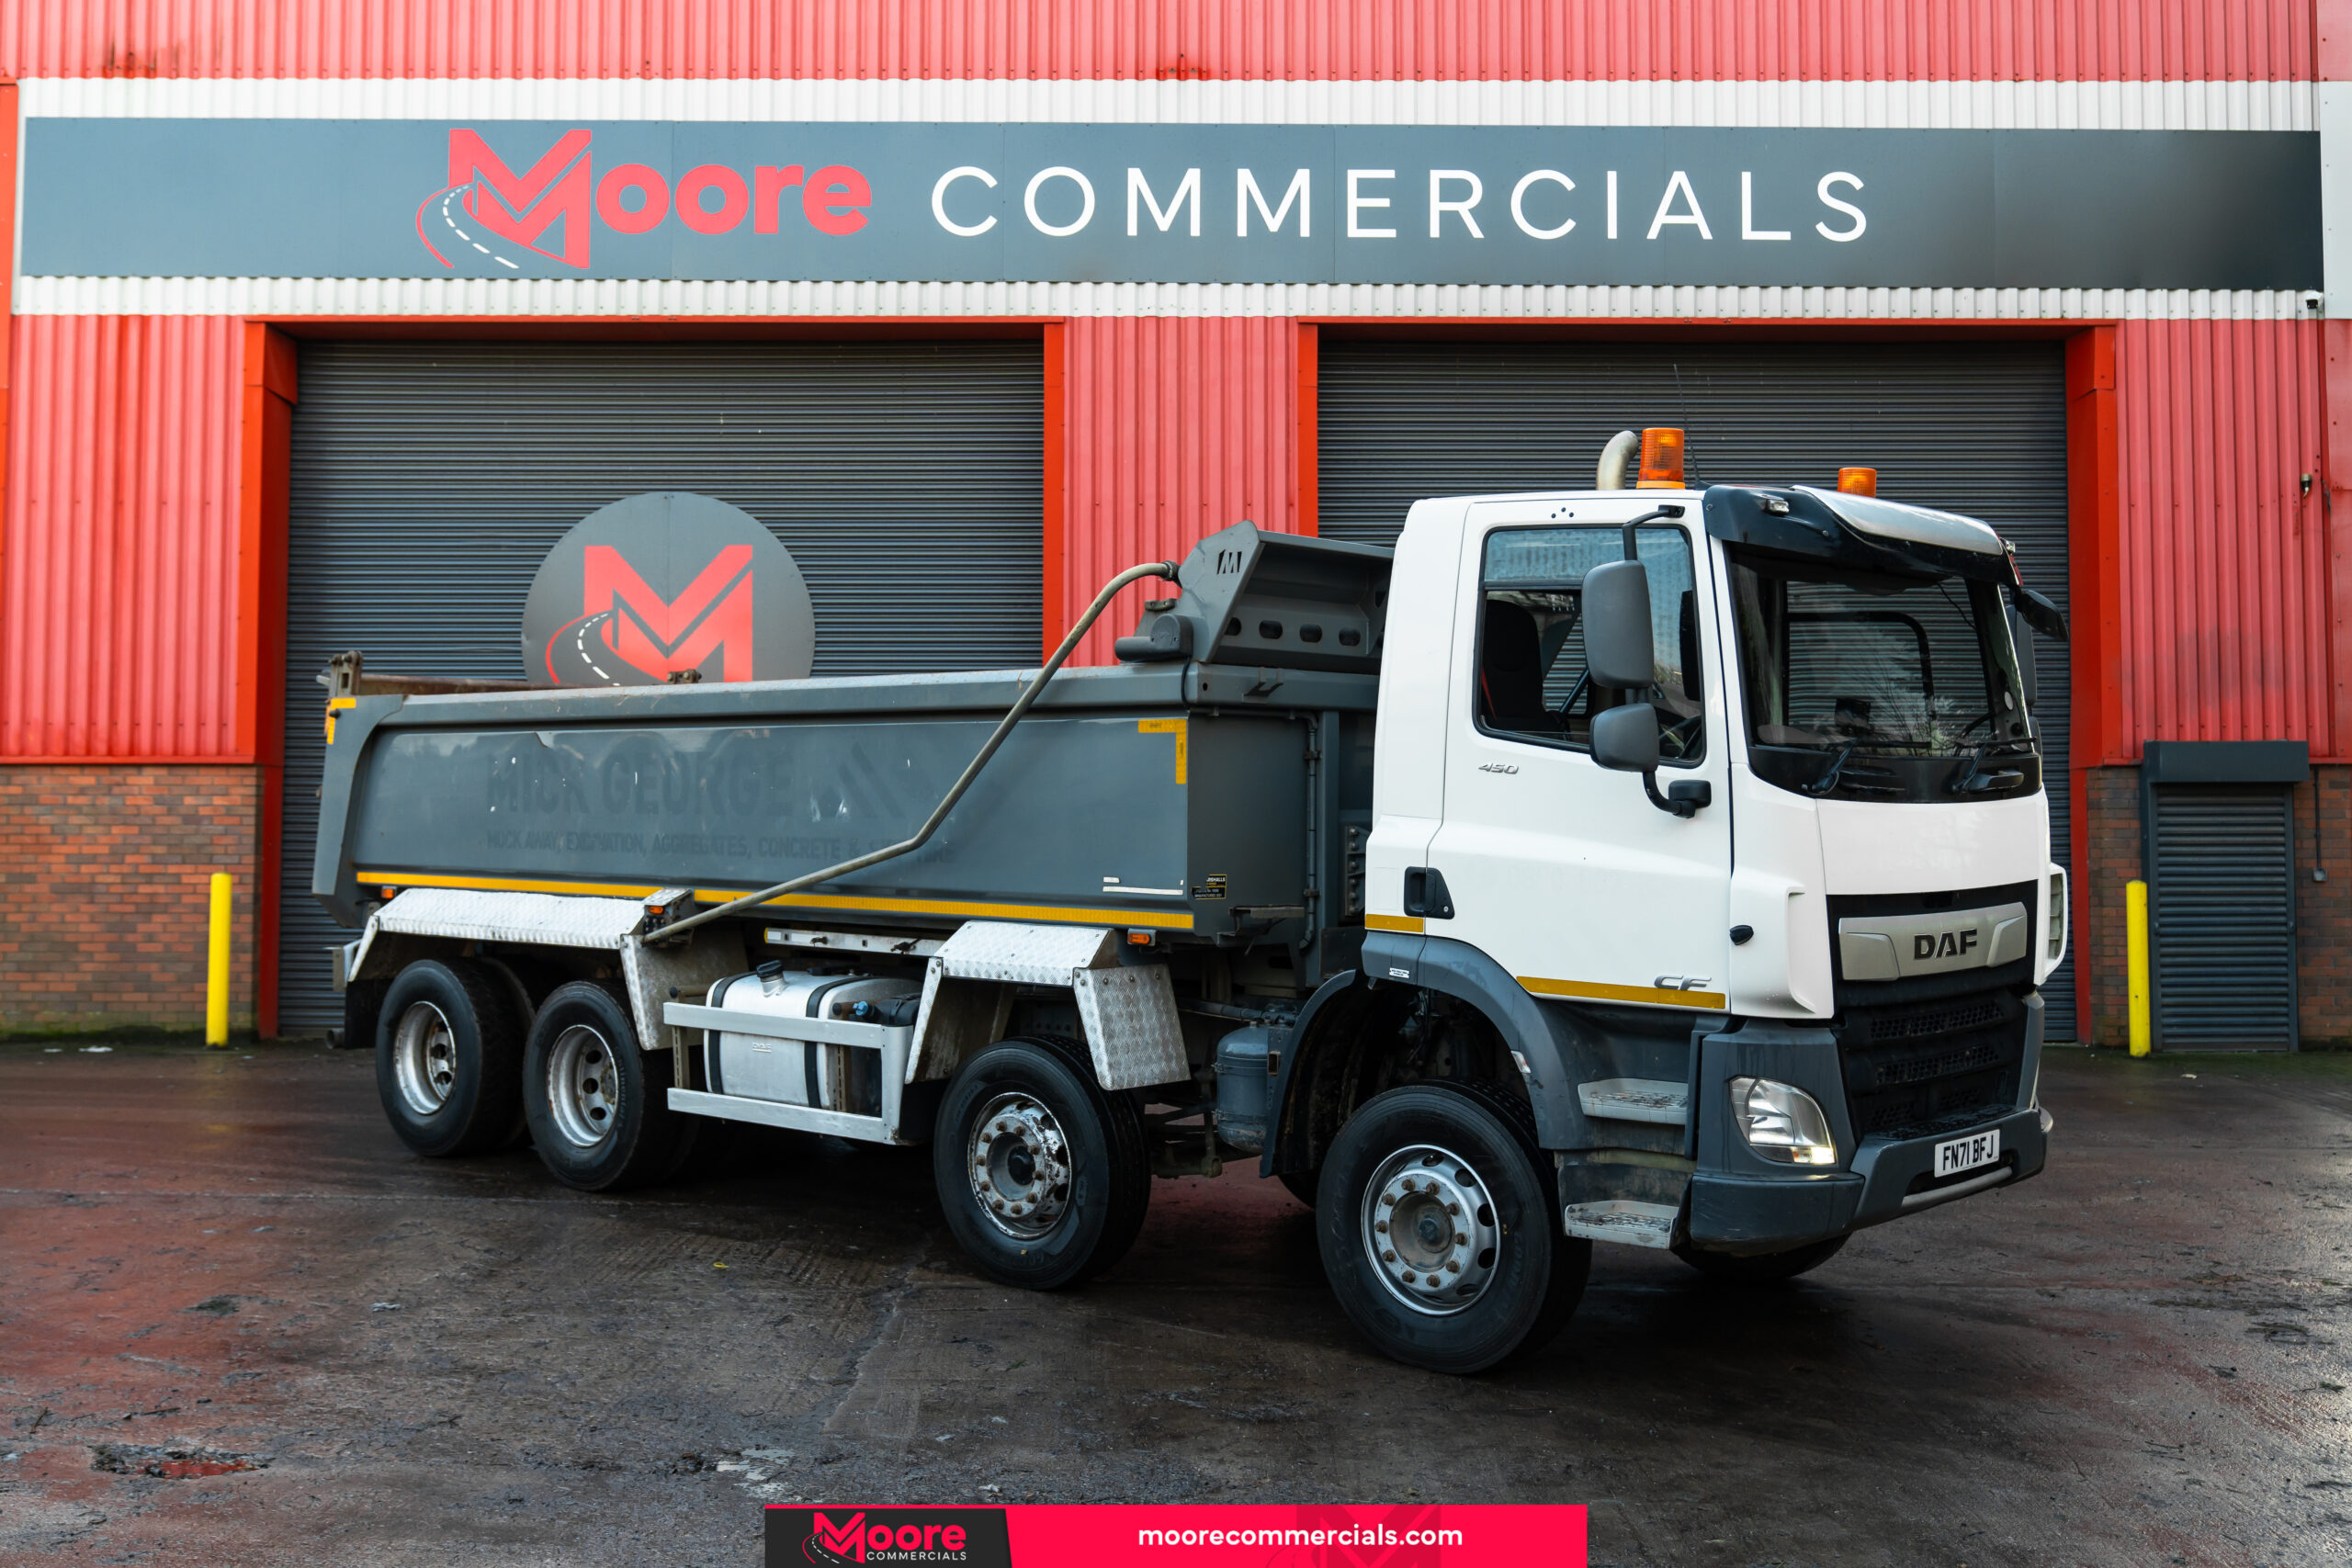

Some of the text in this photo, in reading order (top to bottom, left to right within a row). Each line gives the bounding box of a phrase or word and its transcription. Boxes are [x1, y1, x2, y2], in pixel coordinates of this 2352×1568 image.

[448, 129, 1869, 269] Moore COMMERCIALS
[603, 751, 796, 818] GEORGE
[1477, 762, 1520, 775] 450
[758, 835, 842, 861] CONCRETE
[1914, 928, 1978, 960] DAF
[1653, 975, 1713, 991] CF
[1942, 1134, 1994, 1171] FN71 BFJ
